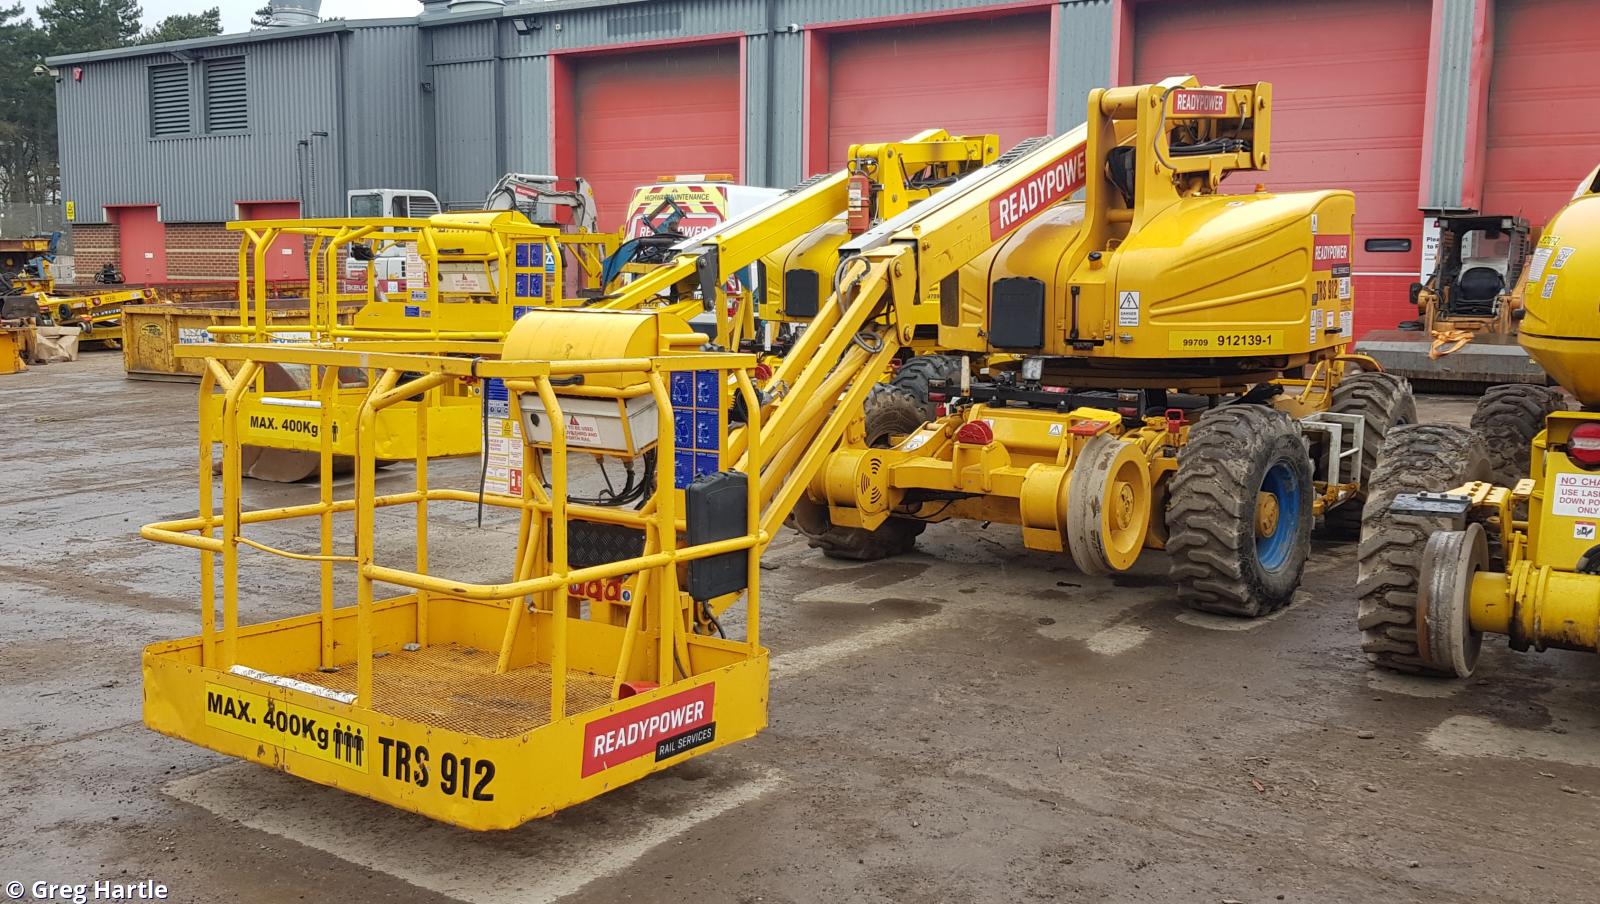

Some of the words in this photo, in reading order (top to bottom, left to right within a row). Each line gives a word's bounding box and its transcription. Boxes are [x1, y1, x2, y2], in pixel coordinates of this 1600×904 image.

[1177, 93, 1224, 111] READYPOWER
[999, 151, 1086, 229] READYPOWE
[1314, 245, 1348, 260] READYPOWER
[1328, 279, 1338, 299] 912
[1182, 338, 1209, 346] 99709
[1217, 334, 1272, 346] 912139-1
[250, 416, 278, 430] MAX.
[282, 419, 318, 437] 400Kg
[1559, 497, 1585, 505] DOWN
[207, 691, 256, 725] MAX.
[263, 705, 329, 750] 400Kg
[593, 700, 705, 758] READYPOWER
[659, 742, 675, 755] RAIL
[678, 728, 712, 749] SERVICES
[378, 736, 430, 788] TRS
[440, 752, 496, 802] 912
